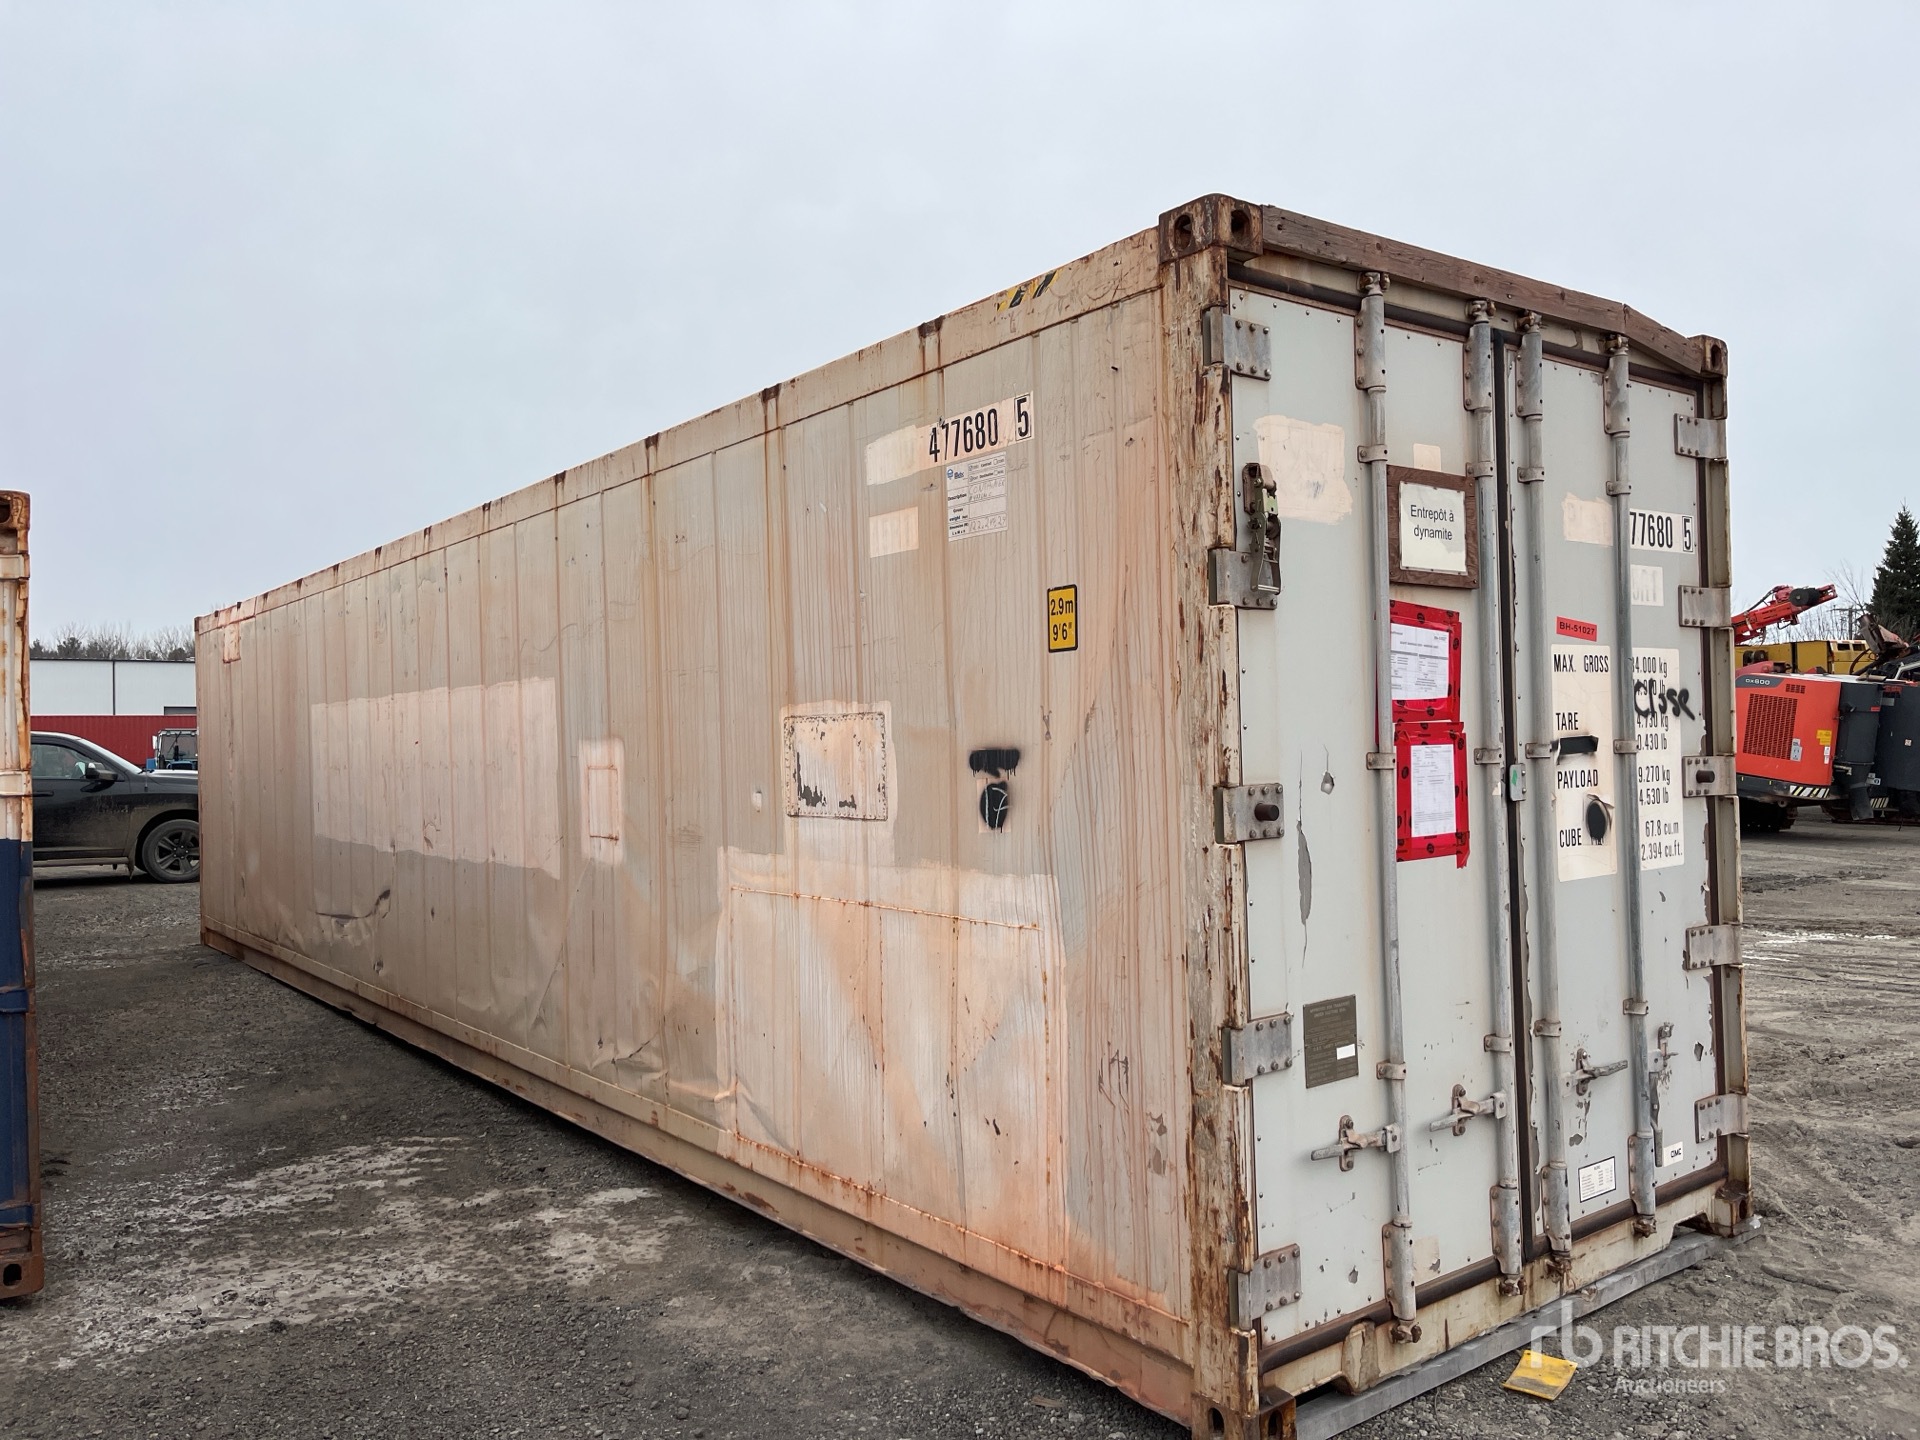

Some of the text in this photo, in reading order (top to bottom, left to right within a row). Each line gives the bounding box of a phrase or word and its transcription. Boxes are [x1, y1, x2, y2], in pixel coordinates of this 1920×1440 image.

[929, 397, 1029, 462] 477680 5
[1410, 504, 1455, 523] Entrepôt à
[1413, 524, 1453, 540] dynamite
[1629, 511, 1692, 550] 77680 5
[1559, 621, 1595, 635] BH-51027
[1553, 654, 1609, 673] MAX. GROSS
[1658, 657, 1668, 678] kg
[1555, 712, 1579, 731] TARE
[1660, 712, 1669, 732] kg
[1661, 733, 1668, 750] lb
[1557, 769, 1599, 789] PAYLOAD
[1661, 765, 1671, 786] kg
[1662, 787, 1669, 804] lb
[1645, 819, 1679, 837] 67.8 cu.m
[1559, 828, 1582, 848] CUBE
[1641, 841, 1662, 861] 2.394
